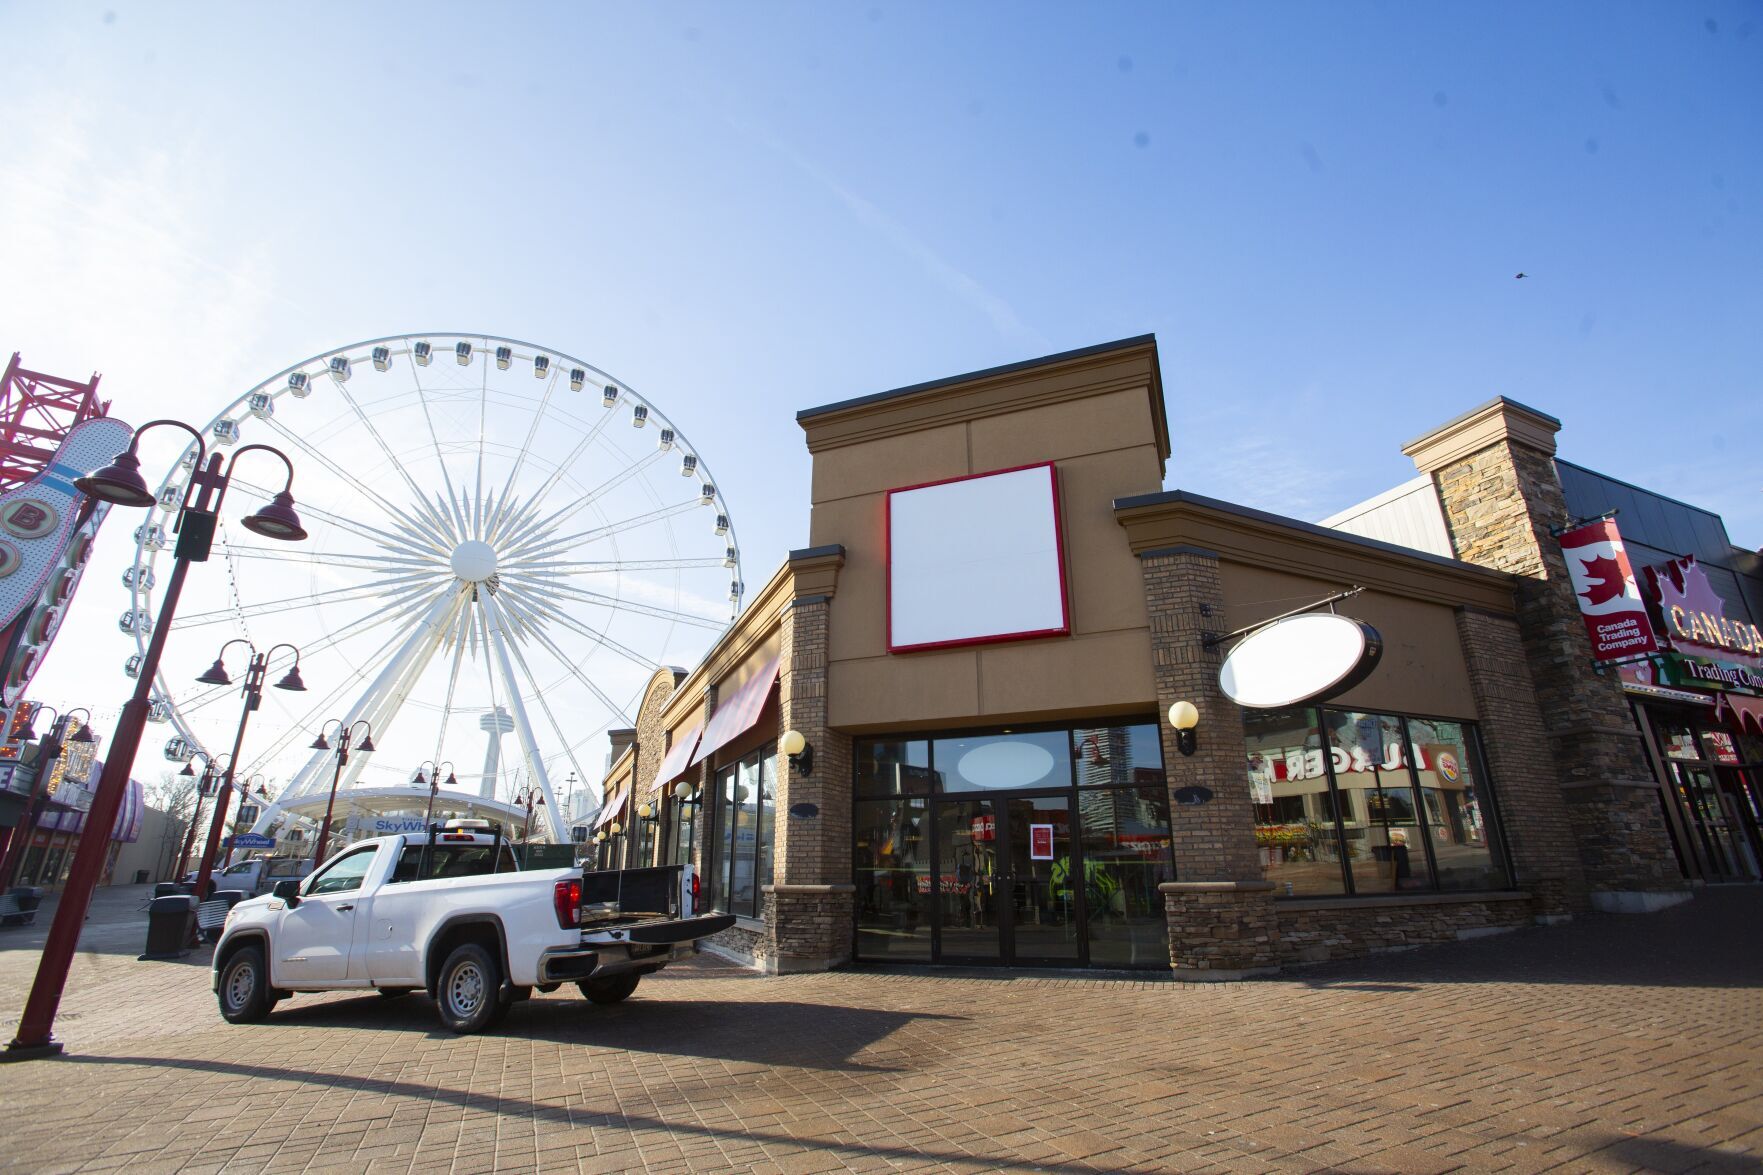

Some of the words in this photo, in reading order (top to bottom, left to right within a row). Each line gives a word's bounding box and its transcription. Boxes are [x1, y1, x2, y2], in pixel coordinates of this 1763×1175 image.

[1597, 619, 1638, 633] Canada
[1670, 605, 1763, 654] CANADA
[1599, 628, 1641, 642] Trading
[1598, 636, 1648, 652] Company
[1684, 659, 1740, 688] Trading
